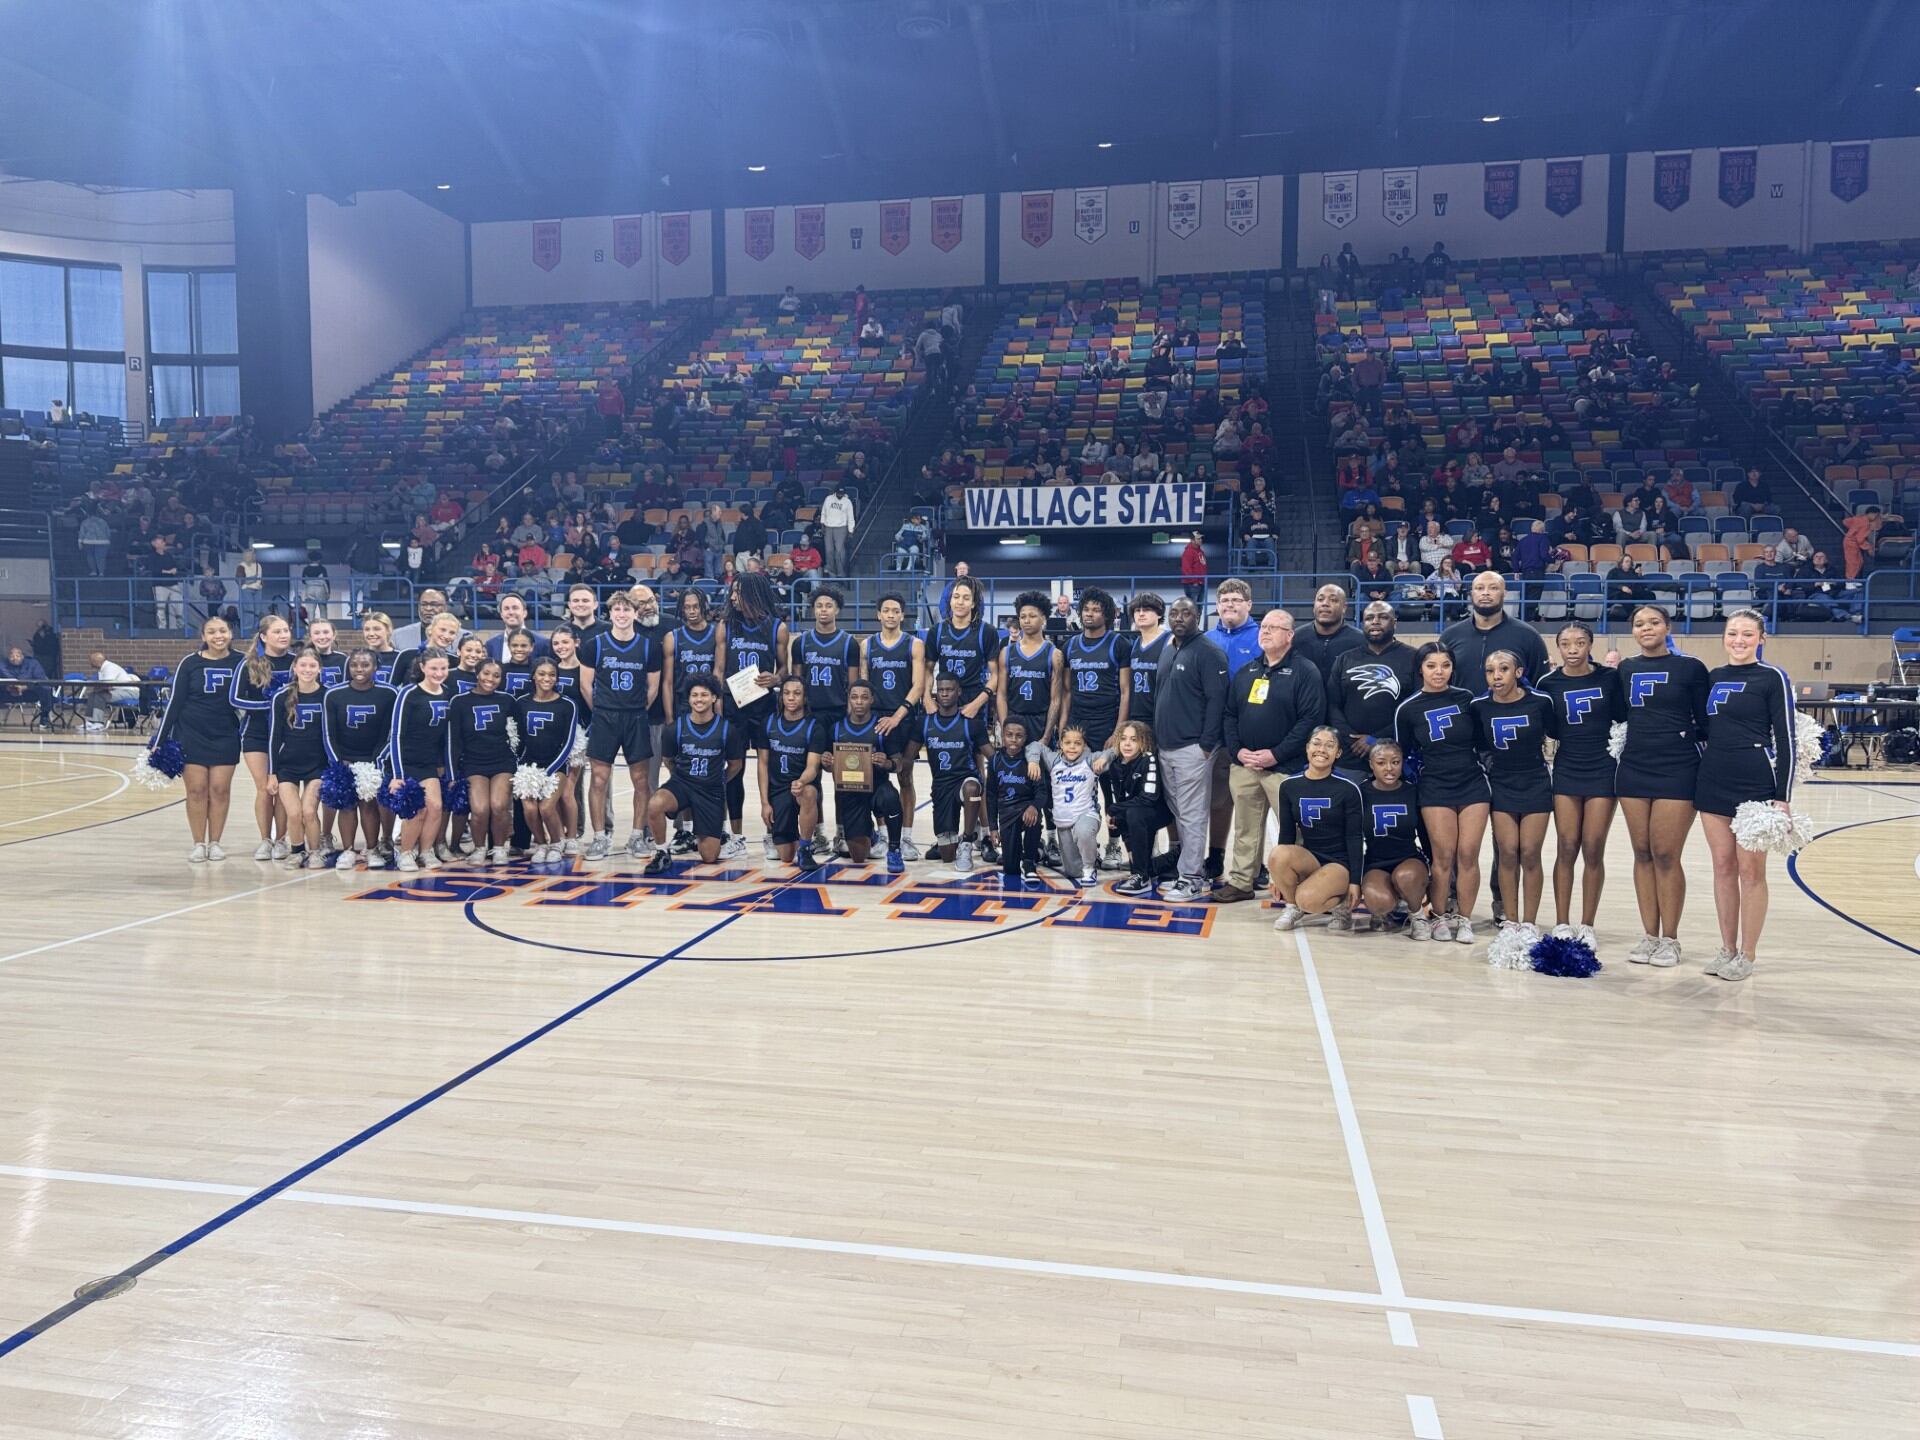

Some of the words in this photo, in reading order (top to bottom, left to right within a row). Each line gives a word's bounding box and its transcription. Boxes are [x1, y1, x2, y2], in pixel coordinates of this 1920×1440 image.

[1771, 185, 1784, 198] W
[1436, 203, 1445, 216] V
[1130, 221, 1139, 233] U
[852, 239, 861, 249] T
[130, 358, 141, 370] R
[967, 486, 1107, 527] WALLACE
[1117, 483, 1203, 525] STATE
[738, 651, 760, 670] 10
[946, 659, 966, 678] 15
[203, 667, 233, 693] F
[505, 672, 532, 696] F
[610, 671, 634, 690] 13
[810, 666, 832, 686] 14
[882, 670, 896, 689] 3
[1077, 671, 1099, 692] 12
[1134, 671, 1150, 692] 21
[1019, 681, 1033, 700] 4
[1629, 672, 1669, 707] F
[1706, 681, 1747, 716] F
[293, 703, 323, 729] F
[429, 701, 449, 726] F
[1563, 687, 1604, 725] F
[346, 705, 376, 729] F
[472, 704, 500, 731] F
[526, 711, 554, 736] F
[1424, 704, 1461, 742] F
[1491, 714, 1529, 750] F
[689, 758, 709, 776] 11
[779, 754, 789, 774] 1
[938, 751, 952, 770] 2
[1055, 770, 1088, 785] Falcons
[1064, 786, 1075, 803] 5
[1299, 797, 1331, 828] F
[1372, 804, 1408, 836] F
[342, 876, 1218, 938] STATE
